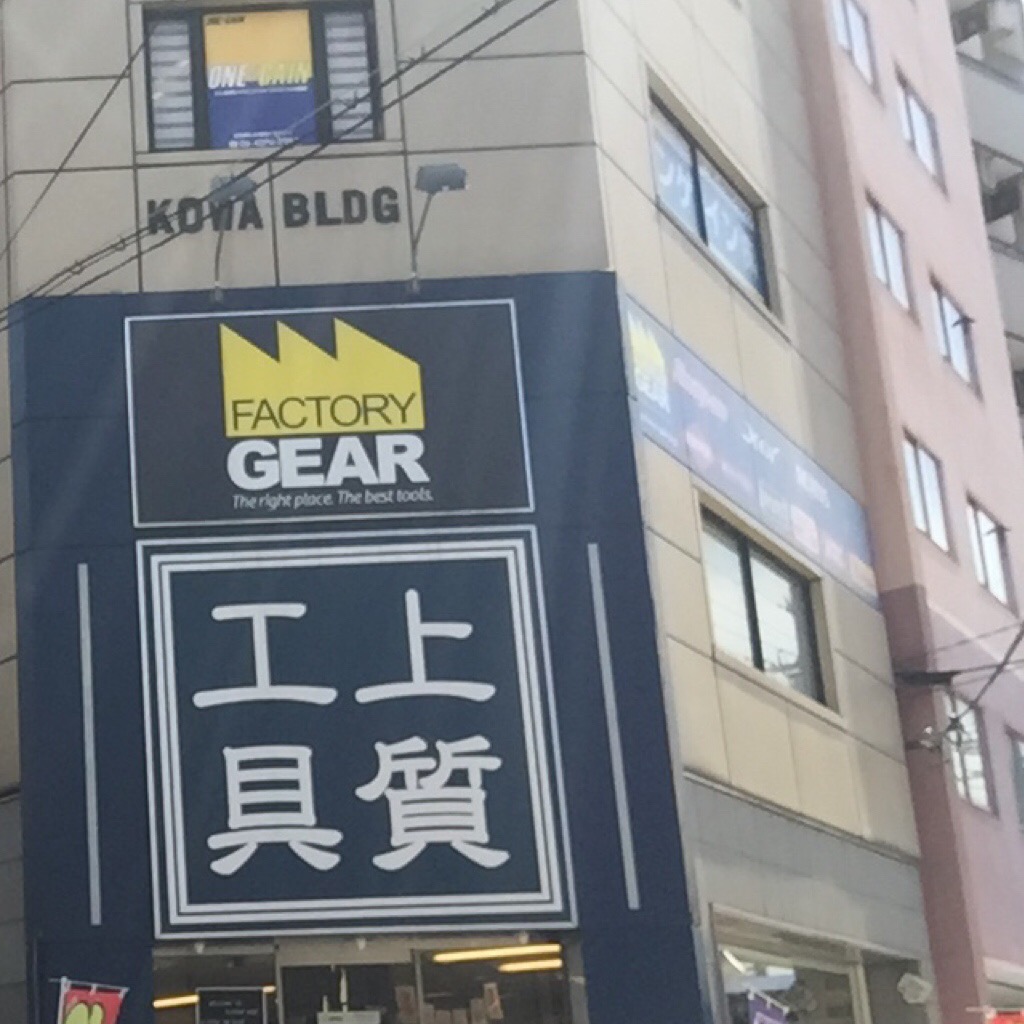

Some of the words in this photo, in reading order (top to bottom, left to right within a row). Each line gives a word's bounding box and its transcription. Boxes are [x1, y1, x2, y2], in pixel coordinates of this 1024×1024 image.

[282, 185, 401, 229] BLDG
[231, 392, 416, 431] FACTORY
[227, 434, 431, 491] GEAR
[233, 494, 257, 510] The
[259, 492, 291, 511] right
[337, 490, 362, 505] The
[364, 489, 394, 504] best
[192, 602, 345, 876] 工具
[354, 588, 511, 871] 上質
